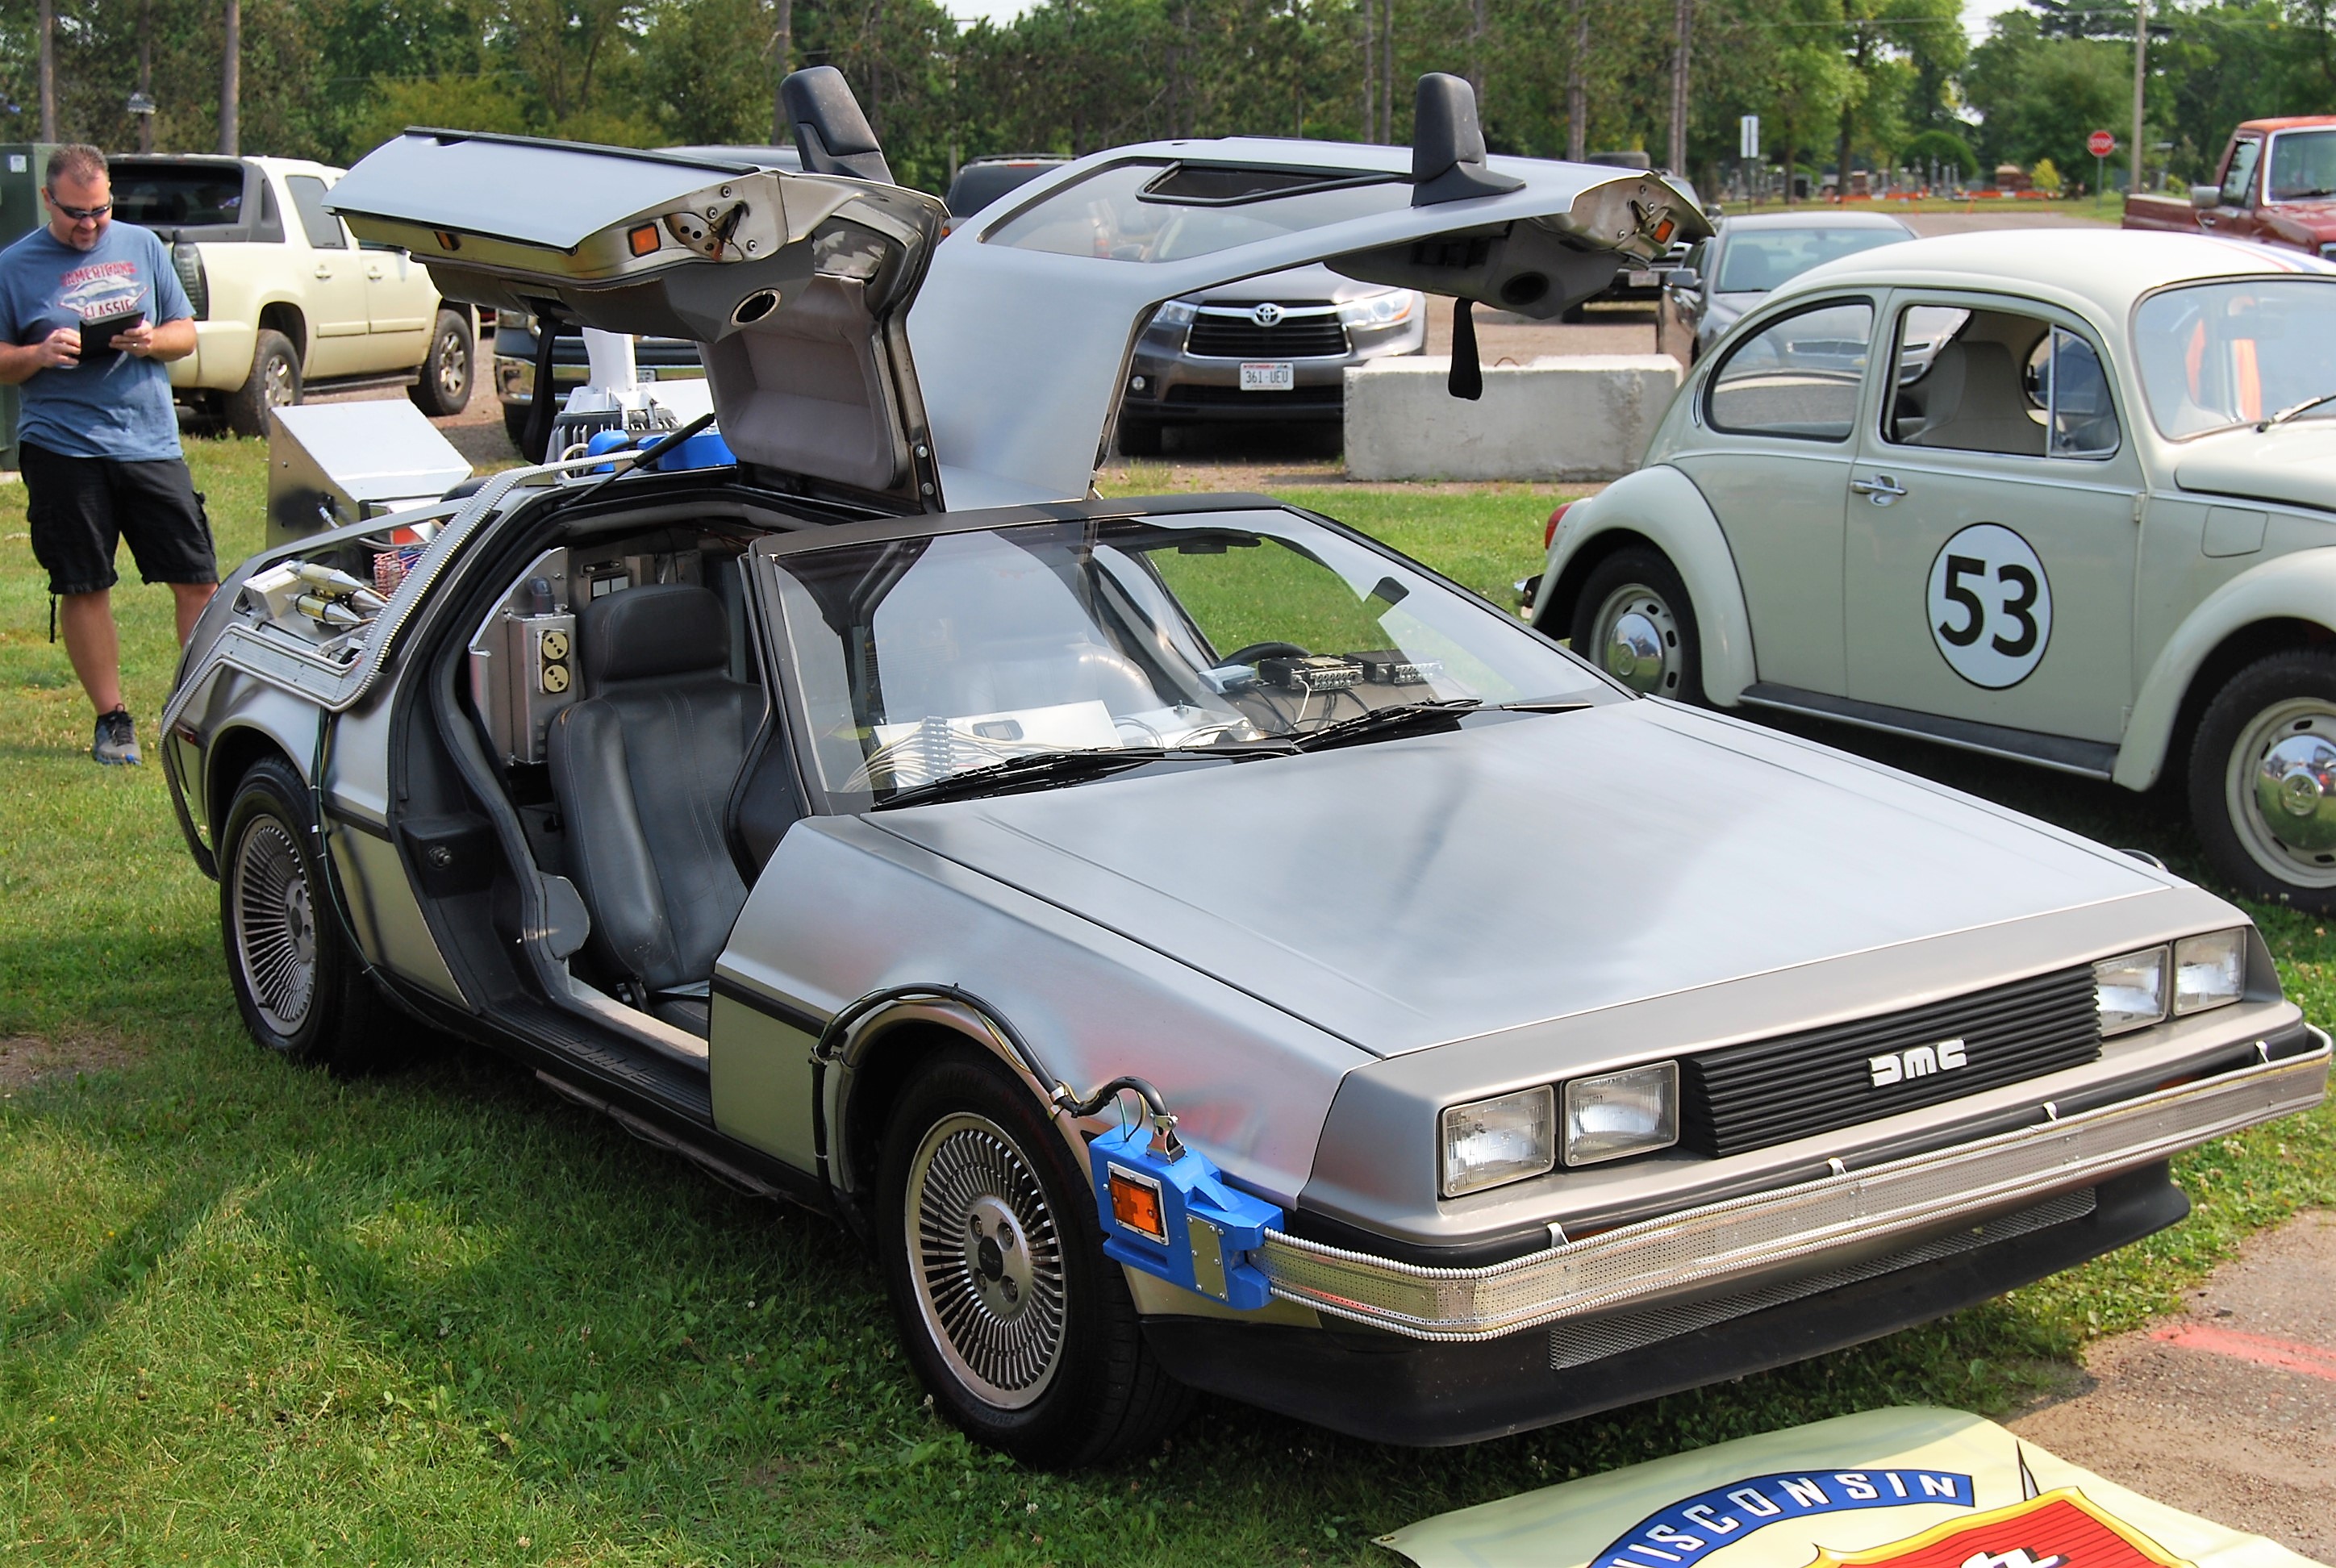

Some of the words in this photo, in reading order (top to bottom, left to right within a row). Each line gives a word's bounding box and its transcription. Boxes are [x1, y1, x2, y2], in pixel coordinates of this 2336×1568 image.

[1938, 554, 2038, 657] 53
[1869, 1037, 1967, 1087] DMC
[1607, 1473, 1957, 1568] ISCONSIN
